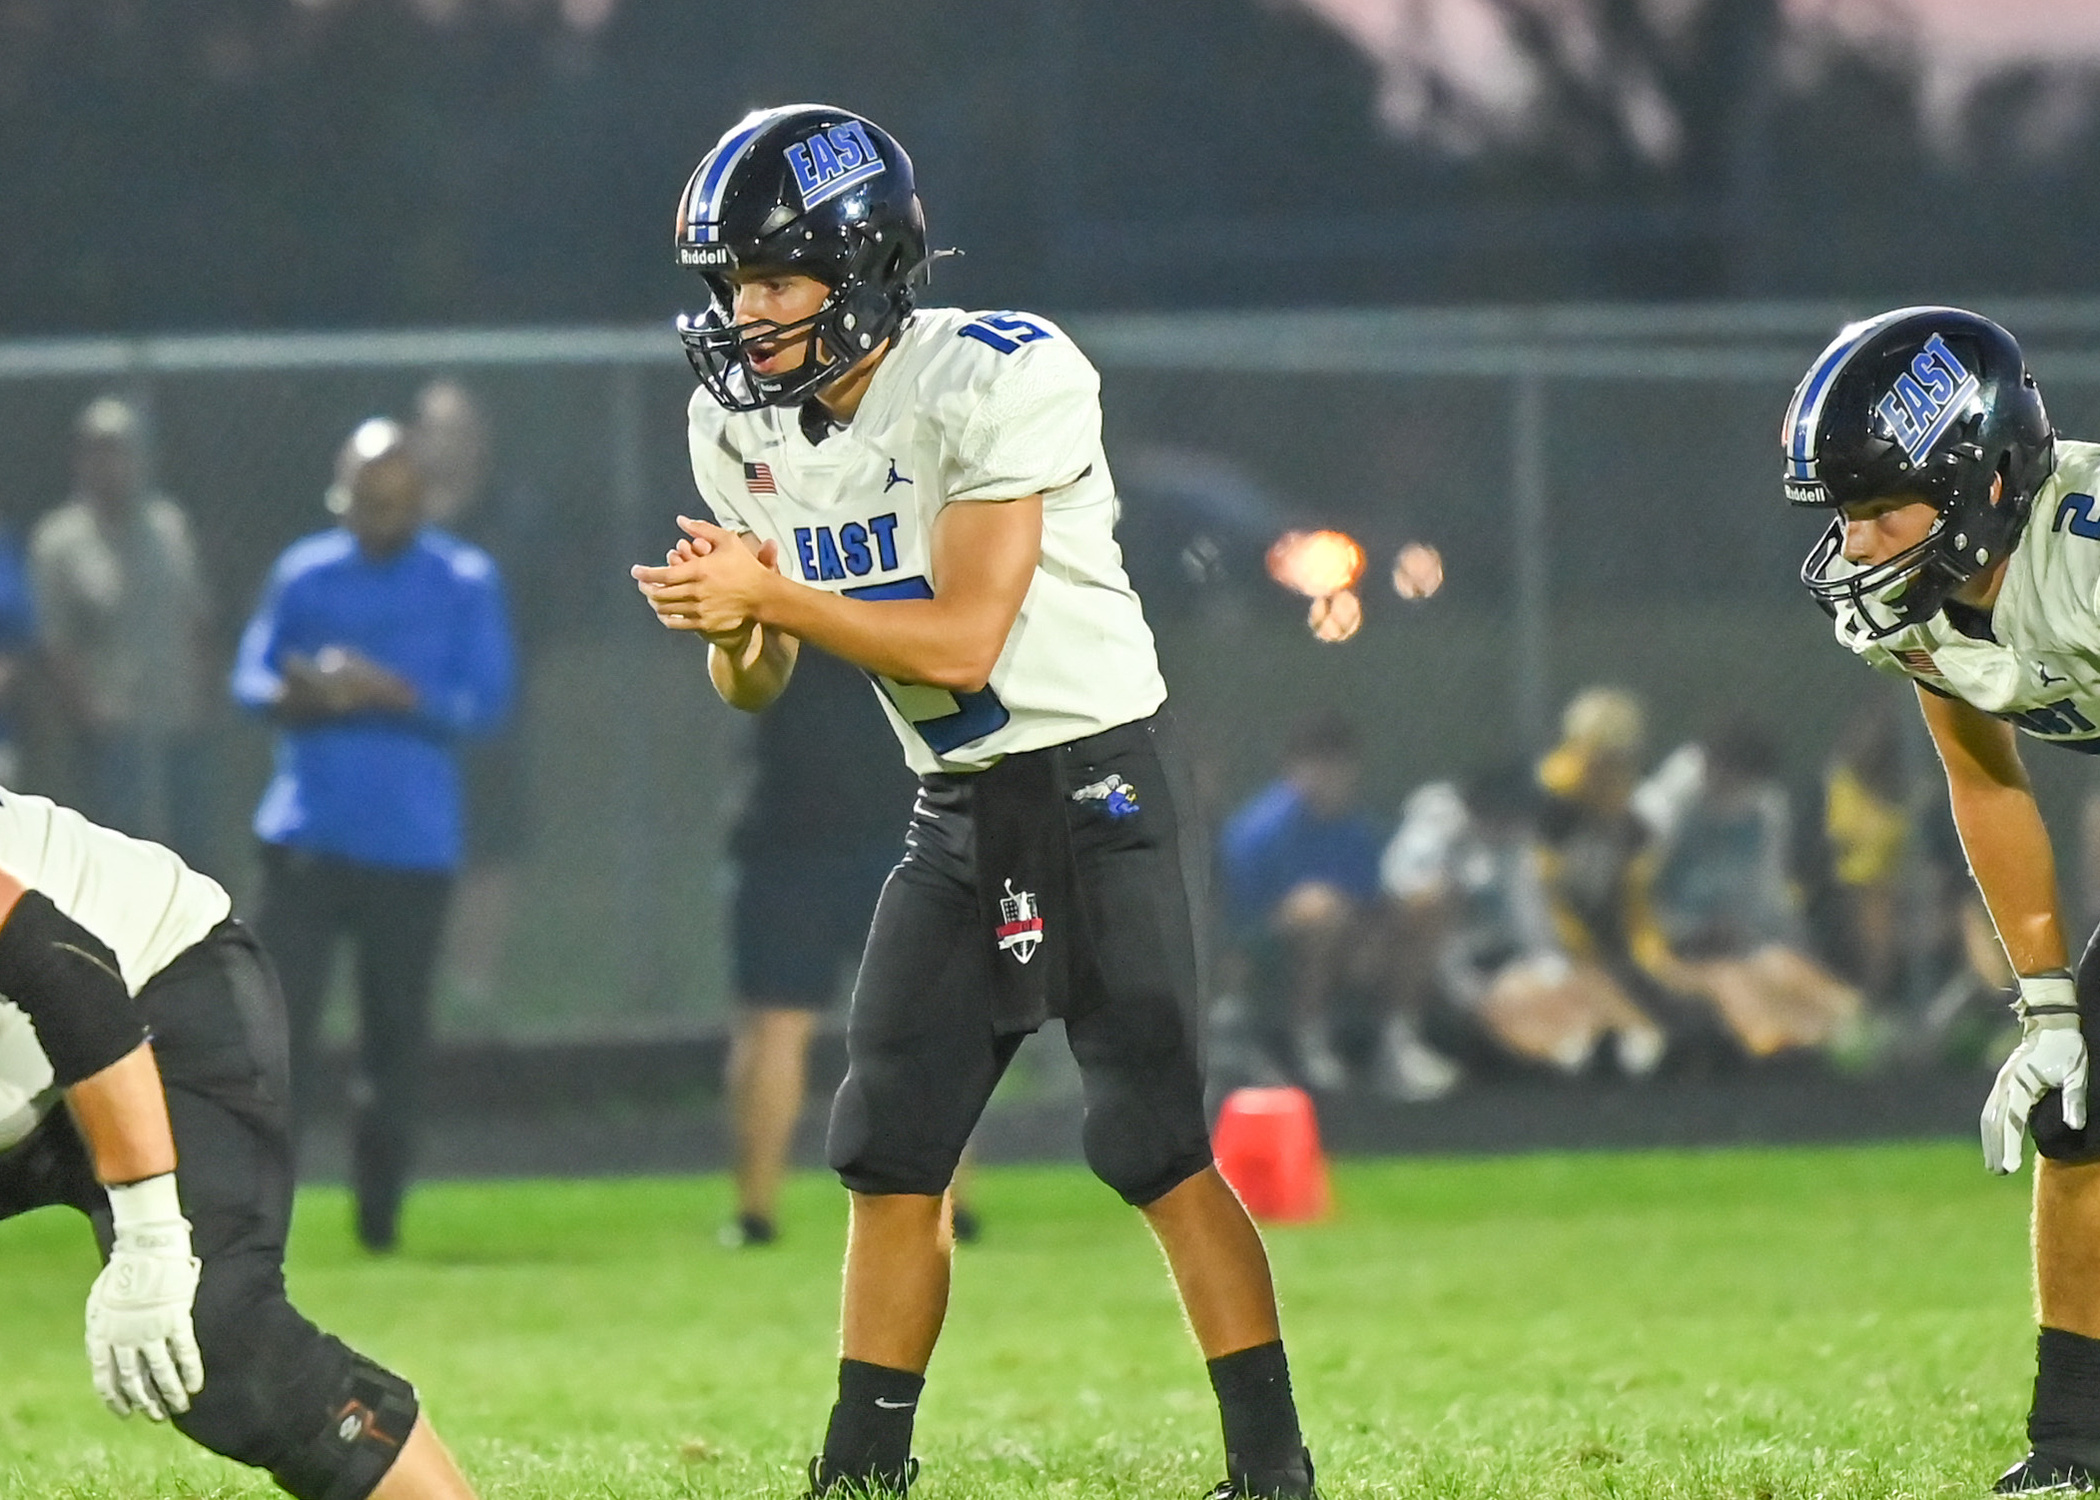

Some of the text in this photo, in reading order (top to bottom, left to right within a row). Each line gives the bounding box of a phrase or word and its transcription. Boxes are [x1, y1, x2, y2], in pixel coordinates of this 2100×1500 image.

[783, 119, 878, 197] EAST
[680, 248, 727, 265] Riddell
[957, 309, 1054, 355] 15
[1878, 332, 1968, 453] EAST
[794, 512, 899, 582] EAST
